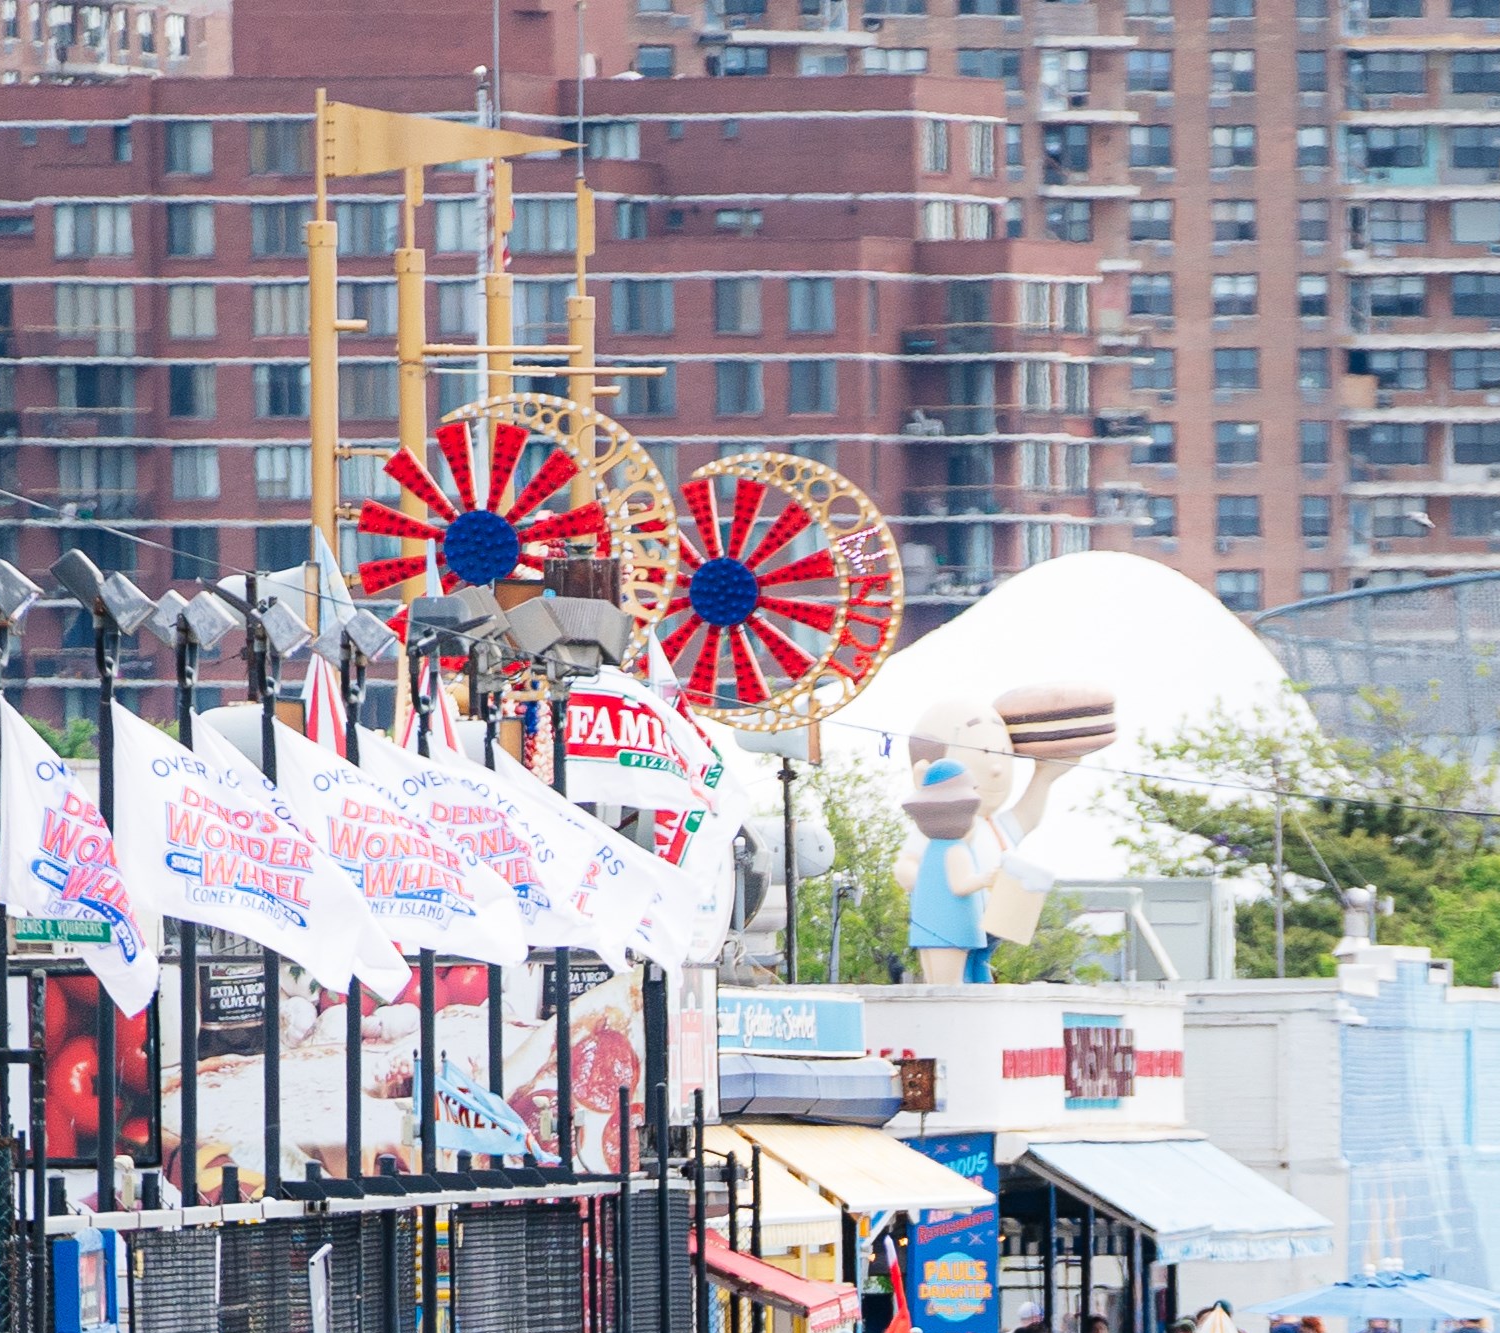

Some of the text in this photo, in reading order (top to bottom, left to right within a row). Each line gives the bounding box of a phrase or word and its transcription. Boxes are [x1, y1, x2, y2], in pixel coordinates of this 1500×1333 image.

[152, 756, 208, 779] OVER
[165, 801, 313, 873] WONDER
[327, 816, 465, 876] WONDER
[200, 850, 312, 909] WHEEL
[362, 862, 475, 901] WHEEL
[192, 887, 282, 921] CONEY ISLAND
[400, 901, 445, 920] ISLAND
[210, 985, 240, 998] EXTRA
[220, 996, 245, 1009] OLIVE
[924, 1260, 988, 1282] PAUL'S
[919, 1283, 993, 1299] DAUGHTER
